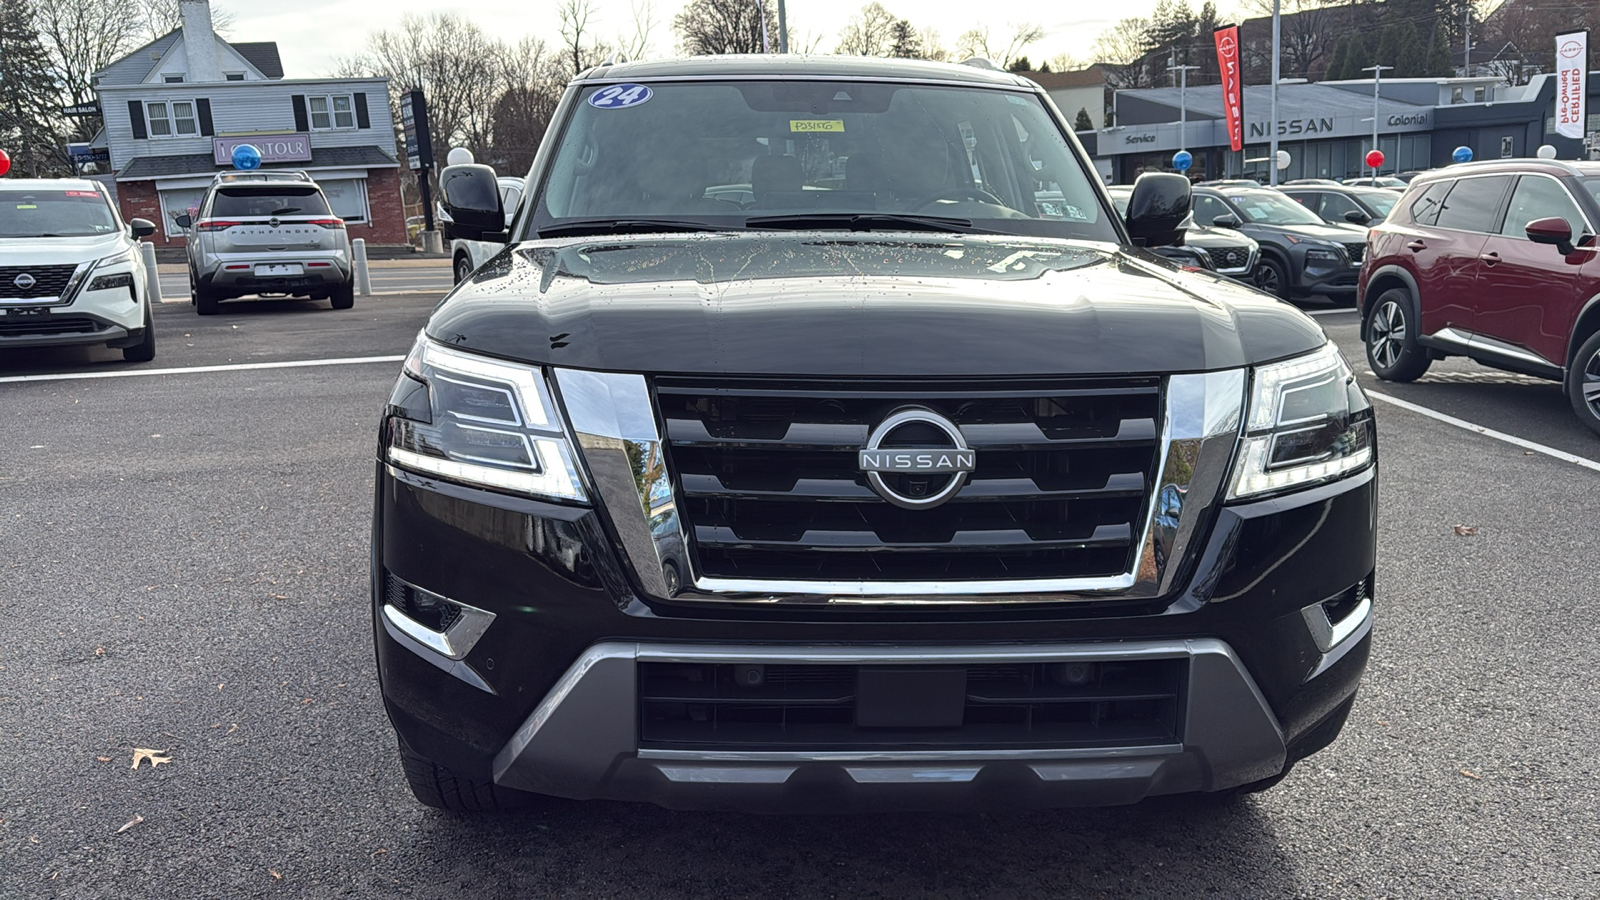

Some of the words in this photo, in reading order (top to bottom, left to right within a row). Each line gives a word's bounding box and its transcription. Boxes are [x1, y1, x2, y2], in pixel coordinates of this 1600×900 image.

[594, 86, 645, 106] 24
[1387, 113, 1428, 127] Colonial
[1250, 117, 1334, 138] NISSAN
[1125, 133, 1156, 145] Service
[863, 454, 972, 468] NISSAN
